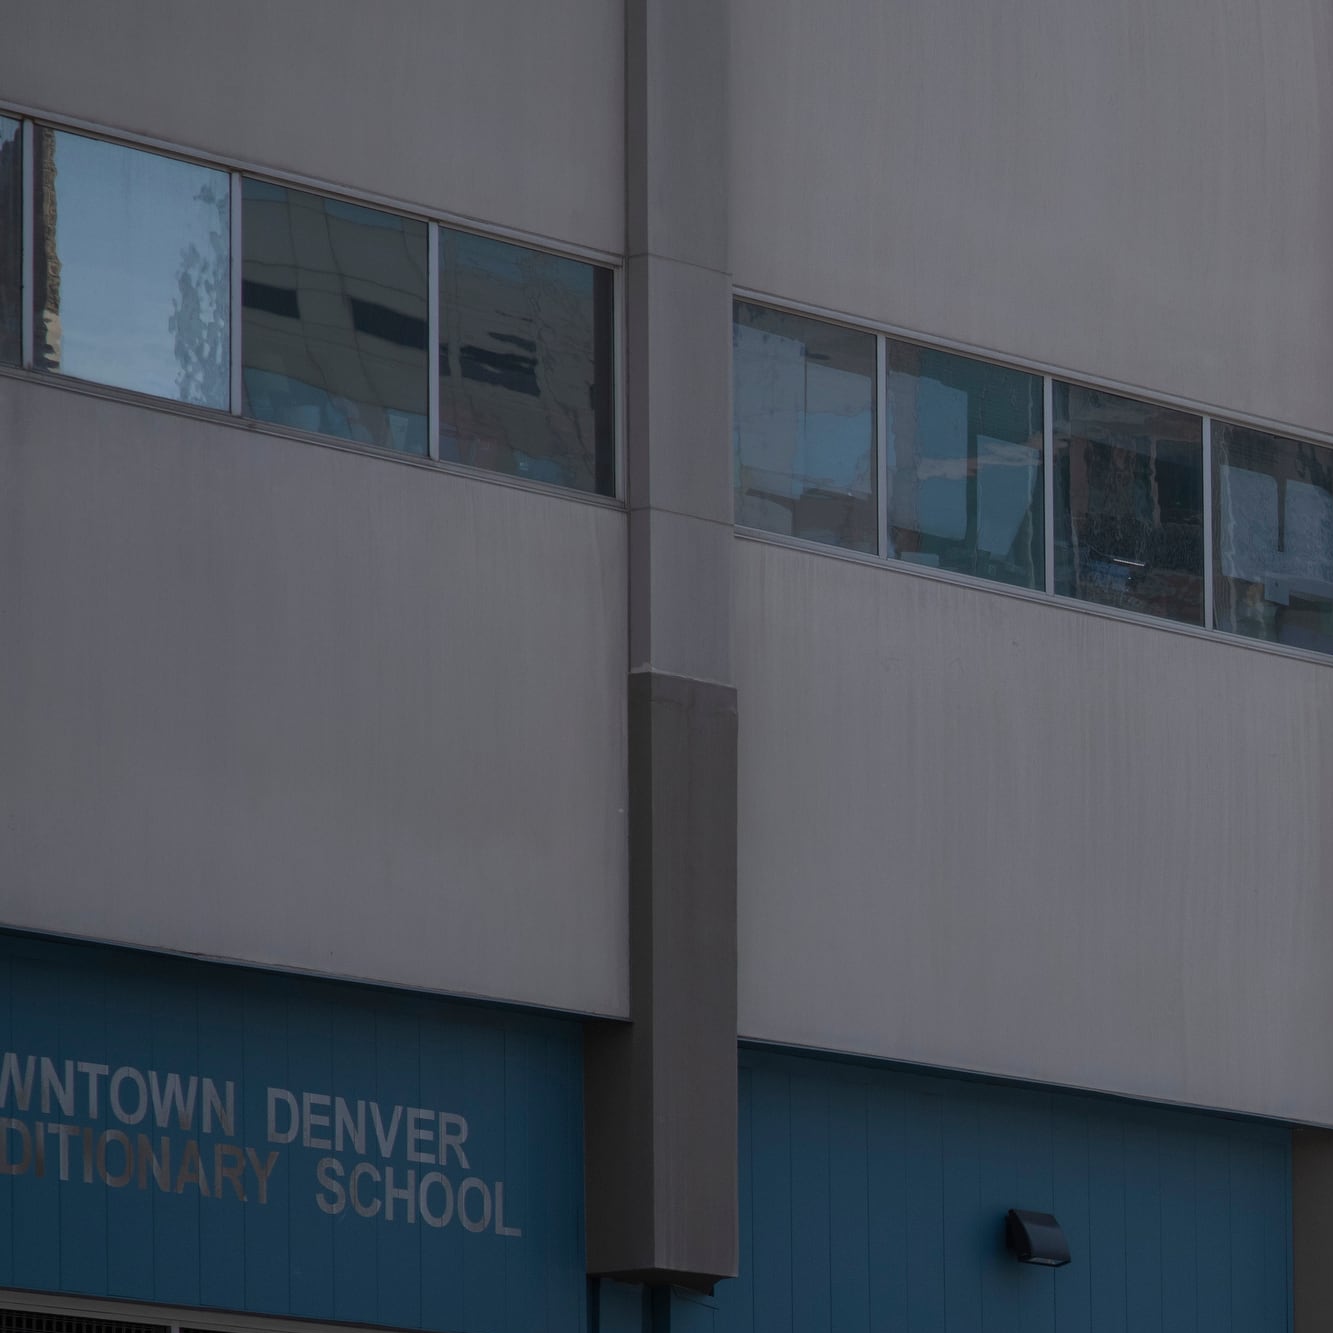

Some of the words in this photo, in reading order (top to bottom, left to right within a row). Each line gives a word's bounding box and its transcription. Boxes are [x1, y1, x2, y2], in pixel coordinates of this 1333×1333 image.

[0, 1117, 281, 1205] DITIONARY
[315, 1156, 523, 1238] SCHOOL
[267, 1087, 471, 1170] DENVER
